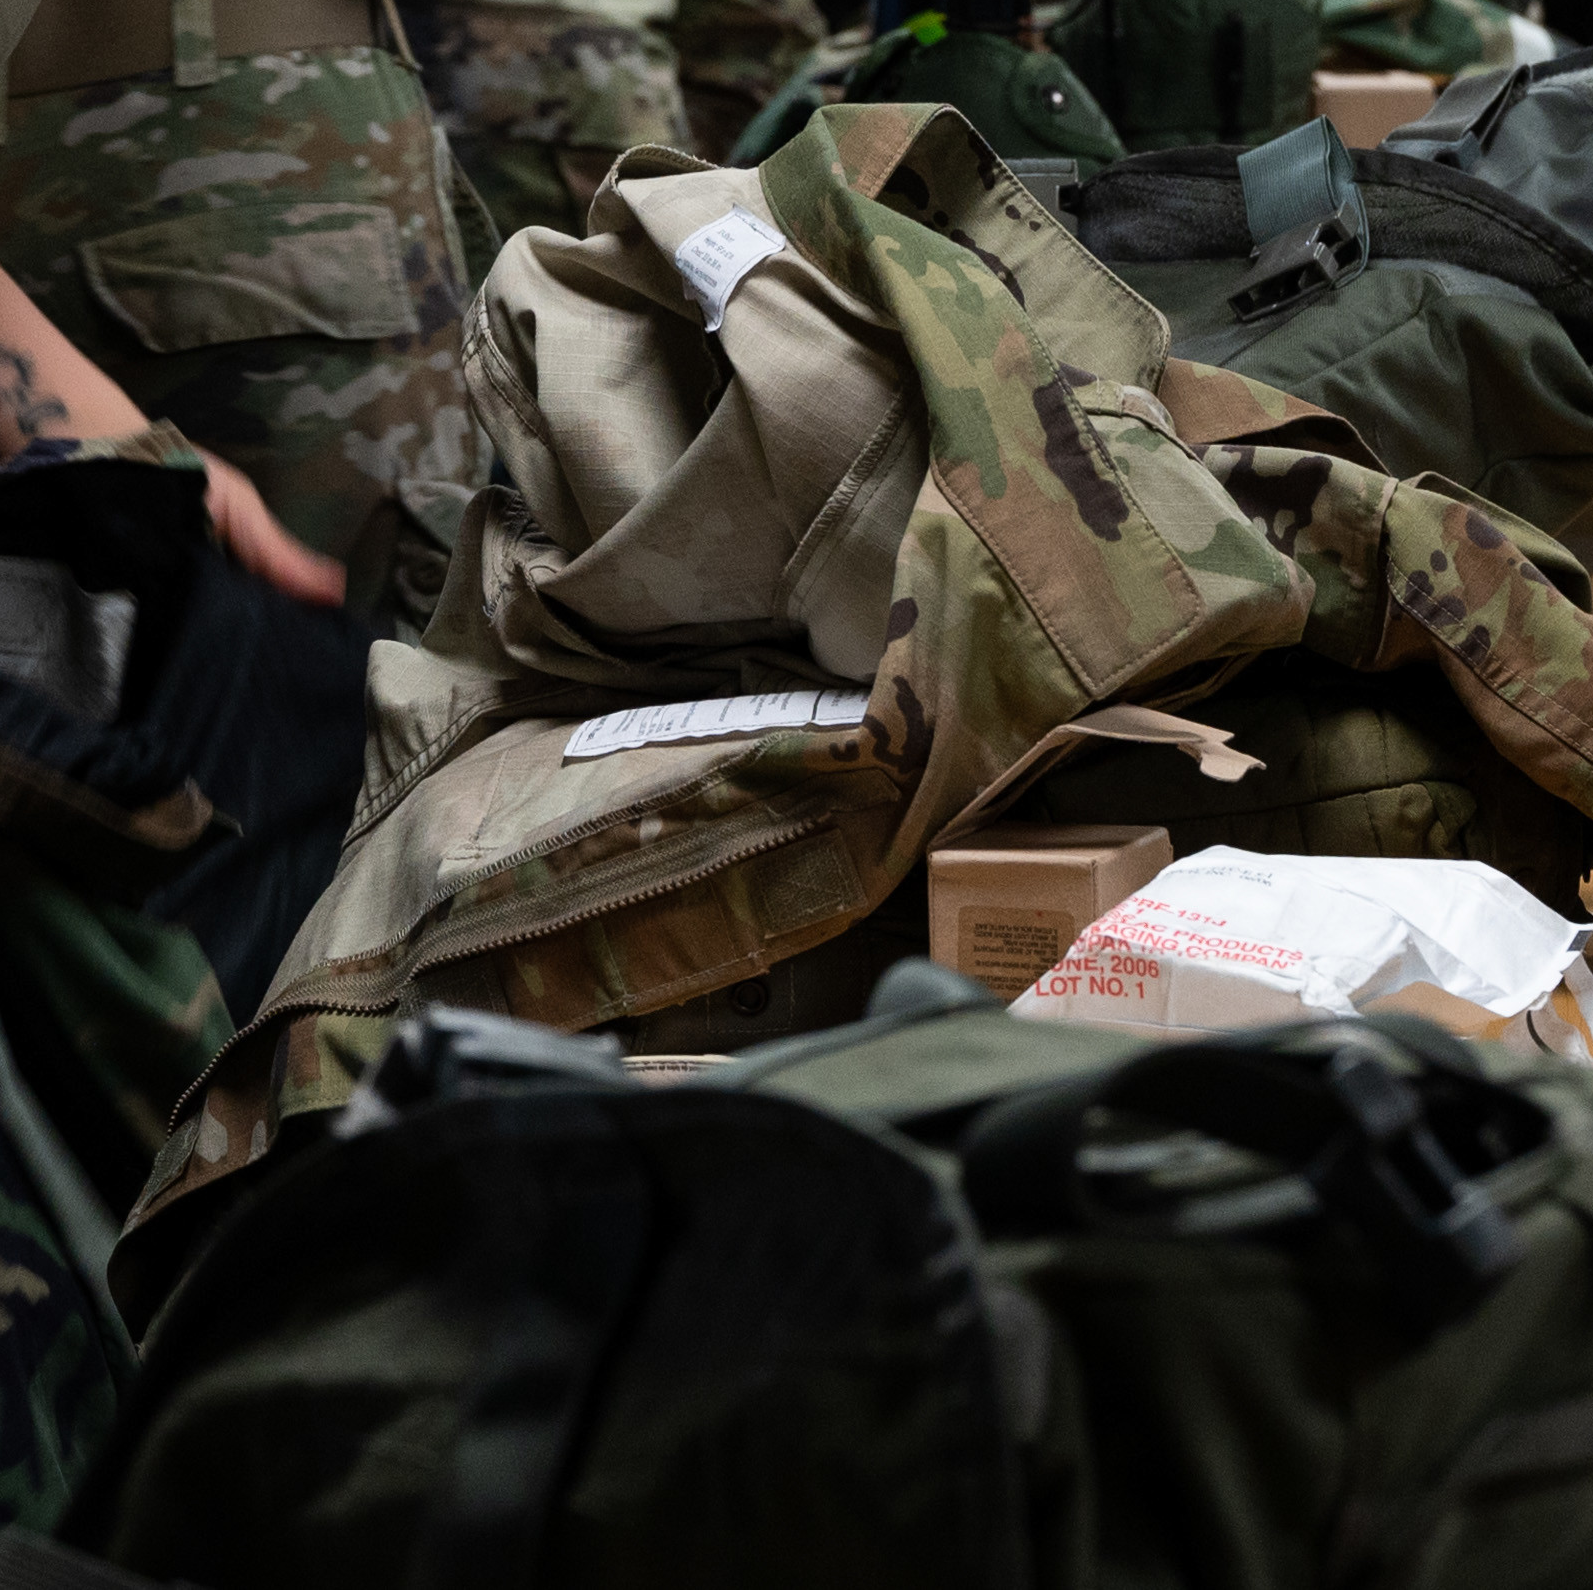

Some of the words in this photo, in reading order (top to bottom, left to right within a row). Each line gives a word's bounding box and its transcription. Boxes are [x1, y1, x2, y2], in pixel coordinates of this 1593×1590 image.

[1173, 930, 1304, 961] PRODUCTS
[1186, 945, 1296, 970] COMPAN
[1110, 955, 1160, 979] 2006
[1035, 975, 1082, 997] LOT
[1089, 975, 1128, 998] NO.
[1136, 981, 1145, 999] 1
